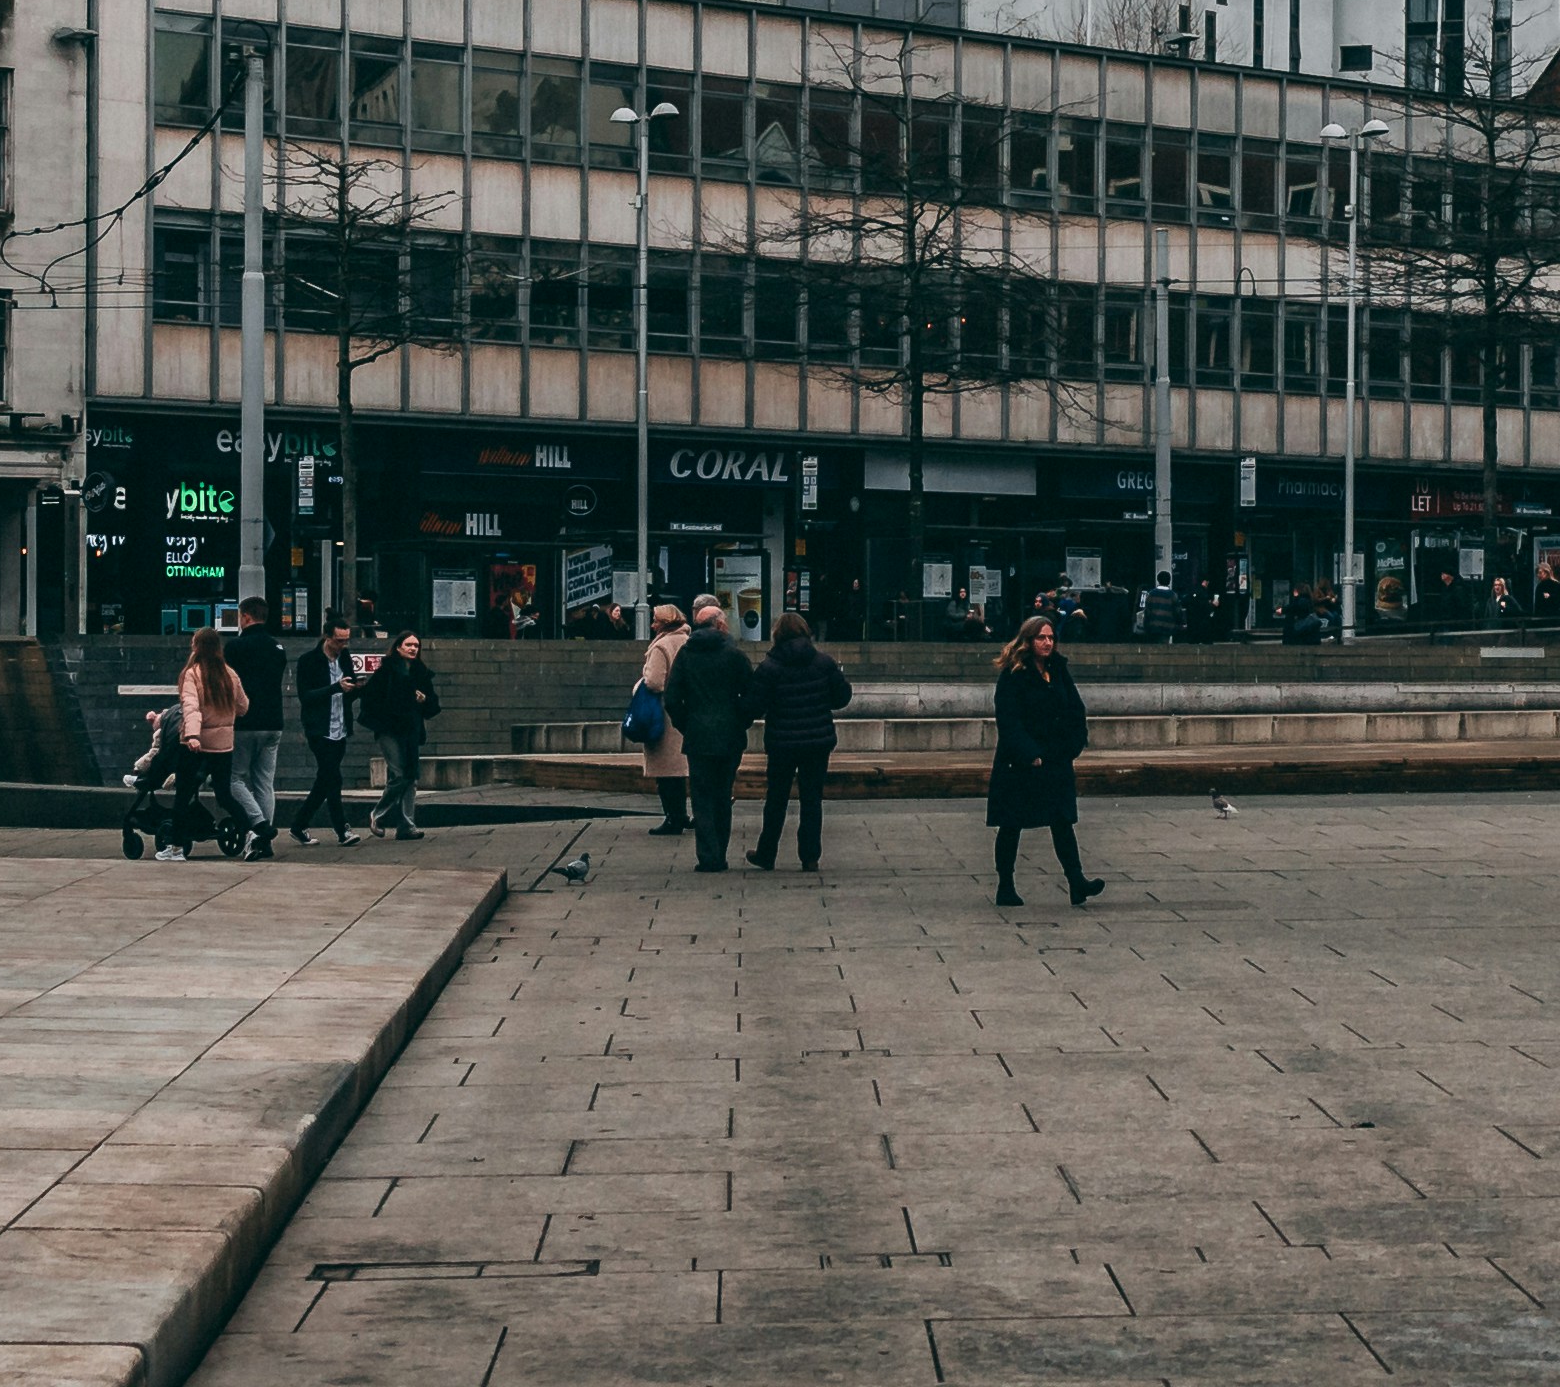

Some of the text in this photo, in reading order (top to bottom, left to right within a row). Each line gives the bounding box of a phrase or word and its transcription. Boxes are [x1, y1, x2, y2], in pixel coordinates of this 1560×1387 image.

[535, 444, 572, 469] HILL
[669, 449, 789, 482] CORAL
[328, 476, 344, 485] easy
[1116, 471, 1155, 490] GREG
[1278, 477, 1347, 500] Pharmacy
[1415, 477, 1429, 494] TO
[166, 481, 235, 520] ybite
[1411, 495, 1431, 513] LET
[465, 512, 502, 537] HILL
[166, 551, 191, 564] ELLO
[567, 552, 590, 567] YOUR
[567, 556, 613, 578] BRAND NE
[166, 565, 225, 578] OTTINGHAM
[567, 568, 613, 591] CORAL SHO
[567, 580, 612, 604] AWAITS YO
